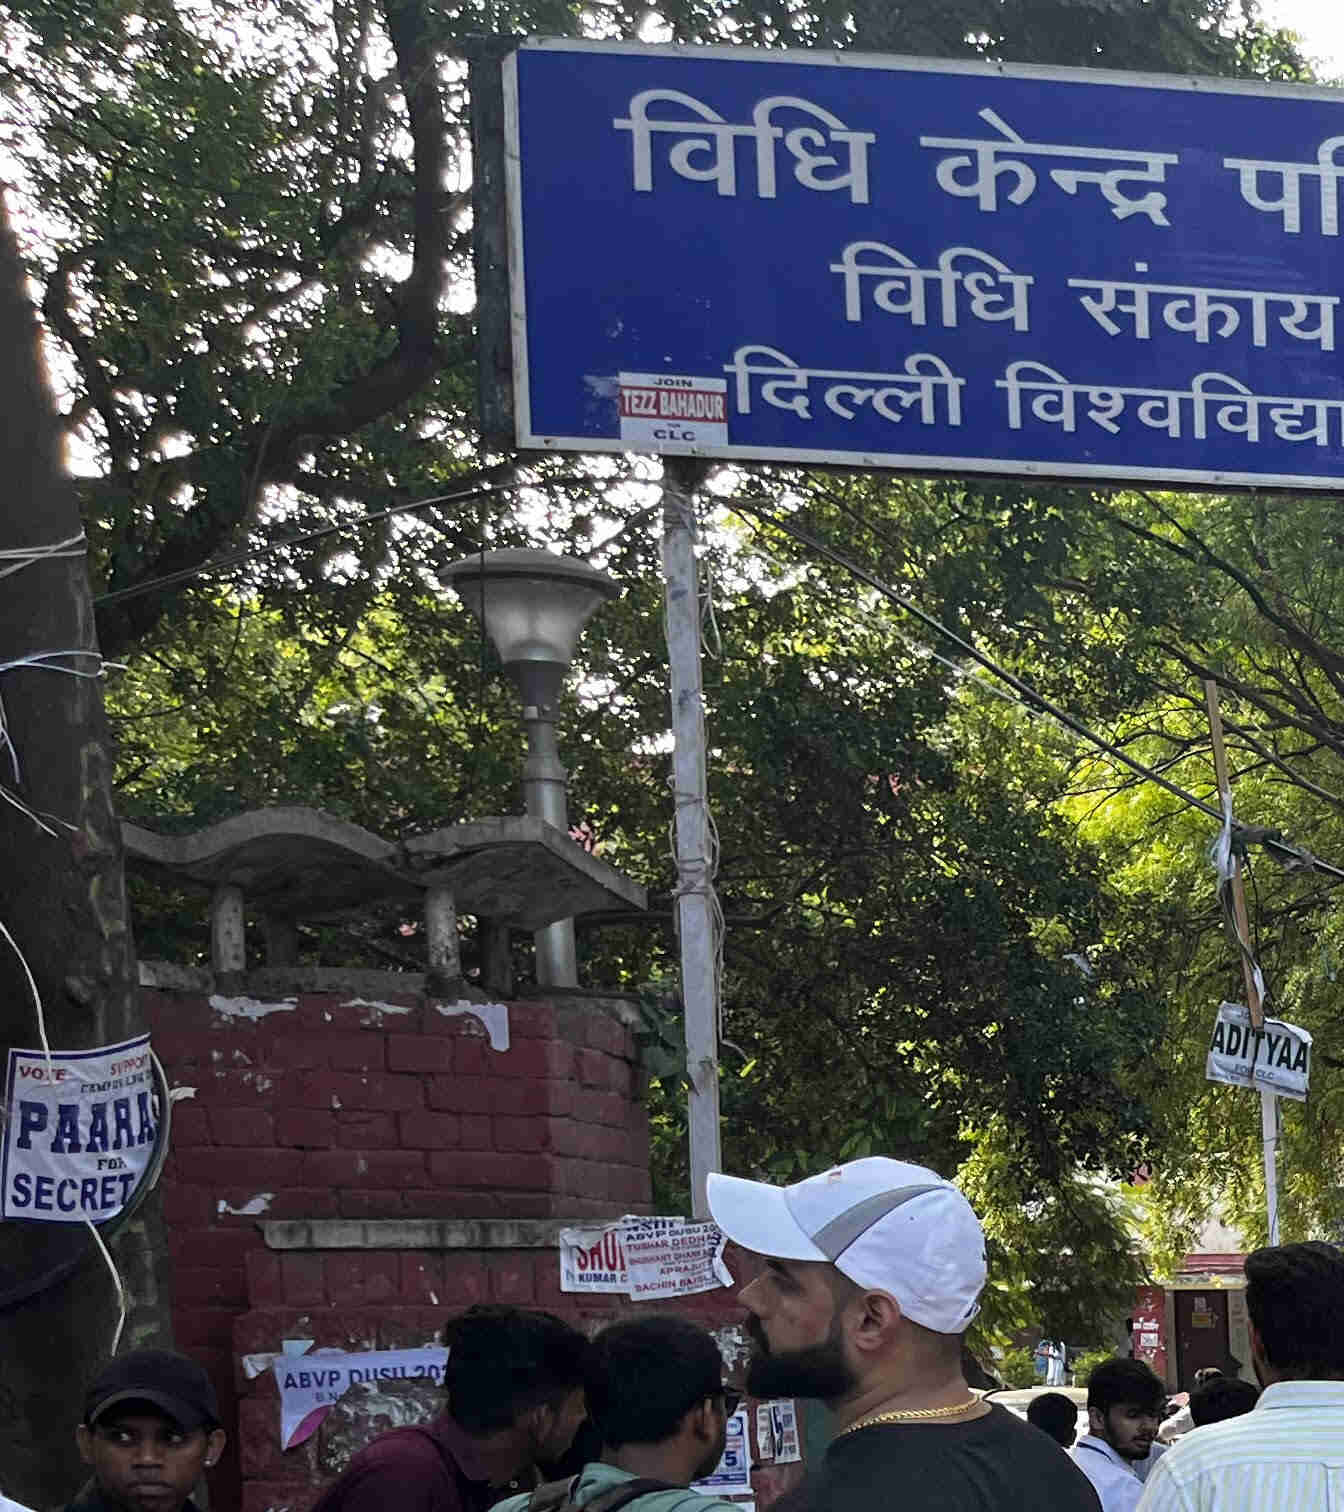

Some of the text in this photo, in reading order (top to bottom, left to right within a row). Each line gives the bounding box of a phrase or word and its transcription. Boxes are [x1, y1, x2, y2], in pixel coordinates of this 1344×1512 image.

[613, 89, 876, 204] विधि
[919, 108, 1178, 226] केन्द्र
[829, 241, 1034, 331] विधि
[654, 378, 693, 387] JOIN
[723, 344, 967, 426] दिल्ली
[623, 389, 725, 419] TEZZ BAHADUR
[653, 429, 696, 441] CLC
[19, 1065, 67, 1081] VOTE
[579, 1272, 616, 1284] KUMAR
[284, 1370, 341, 1389] ABVP
